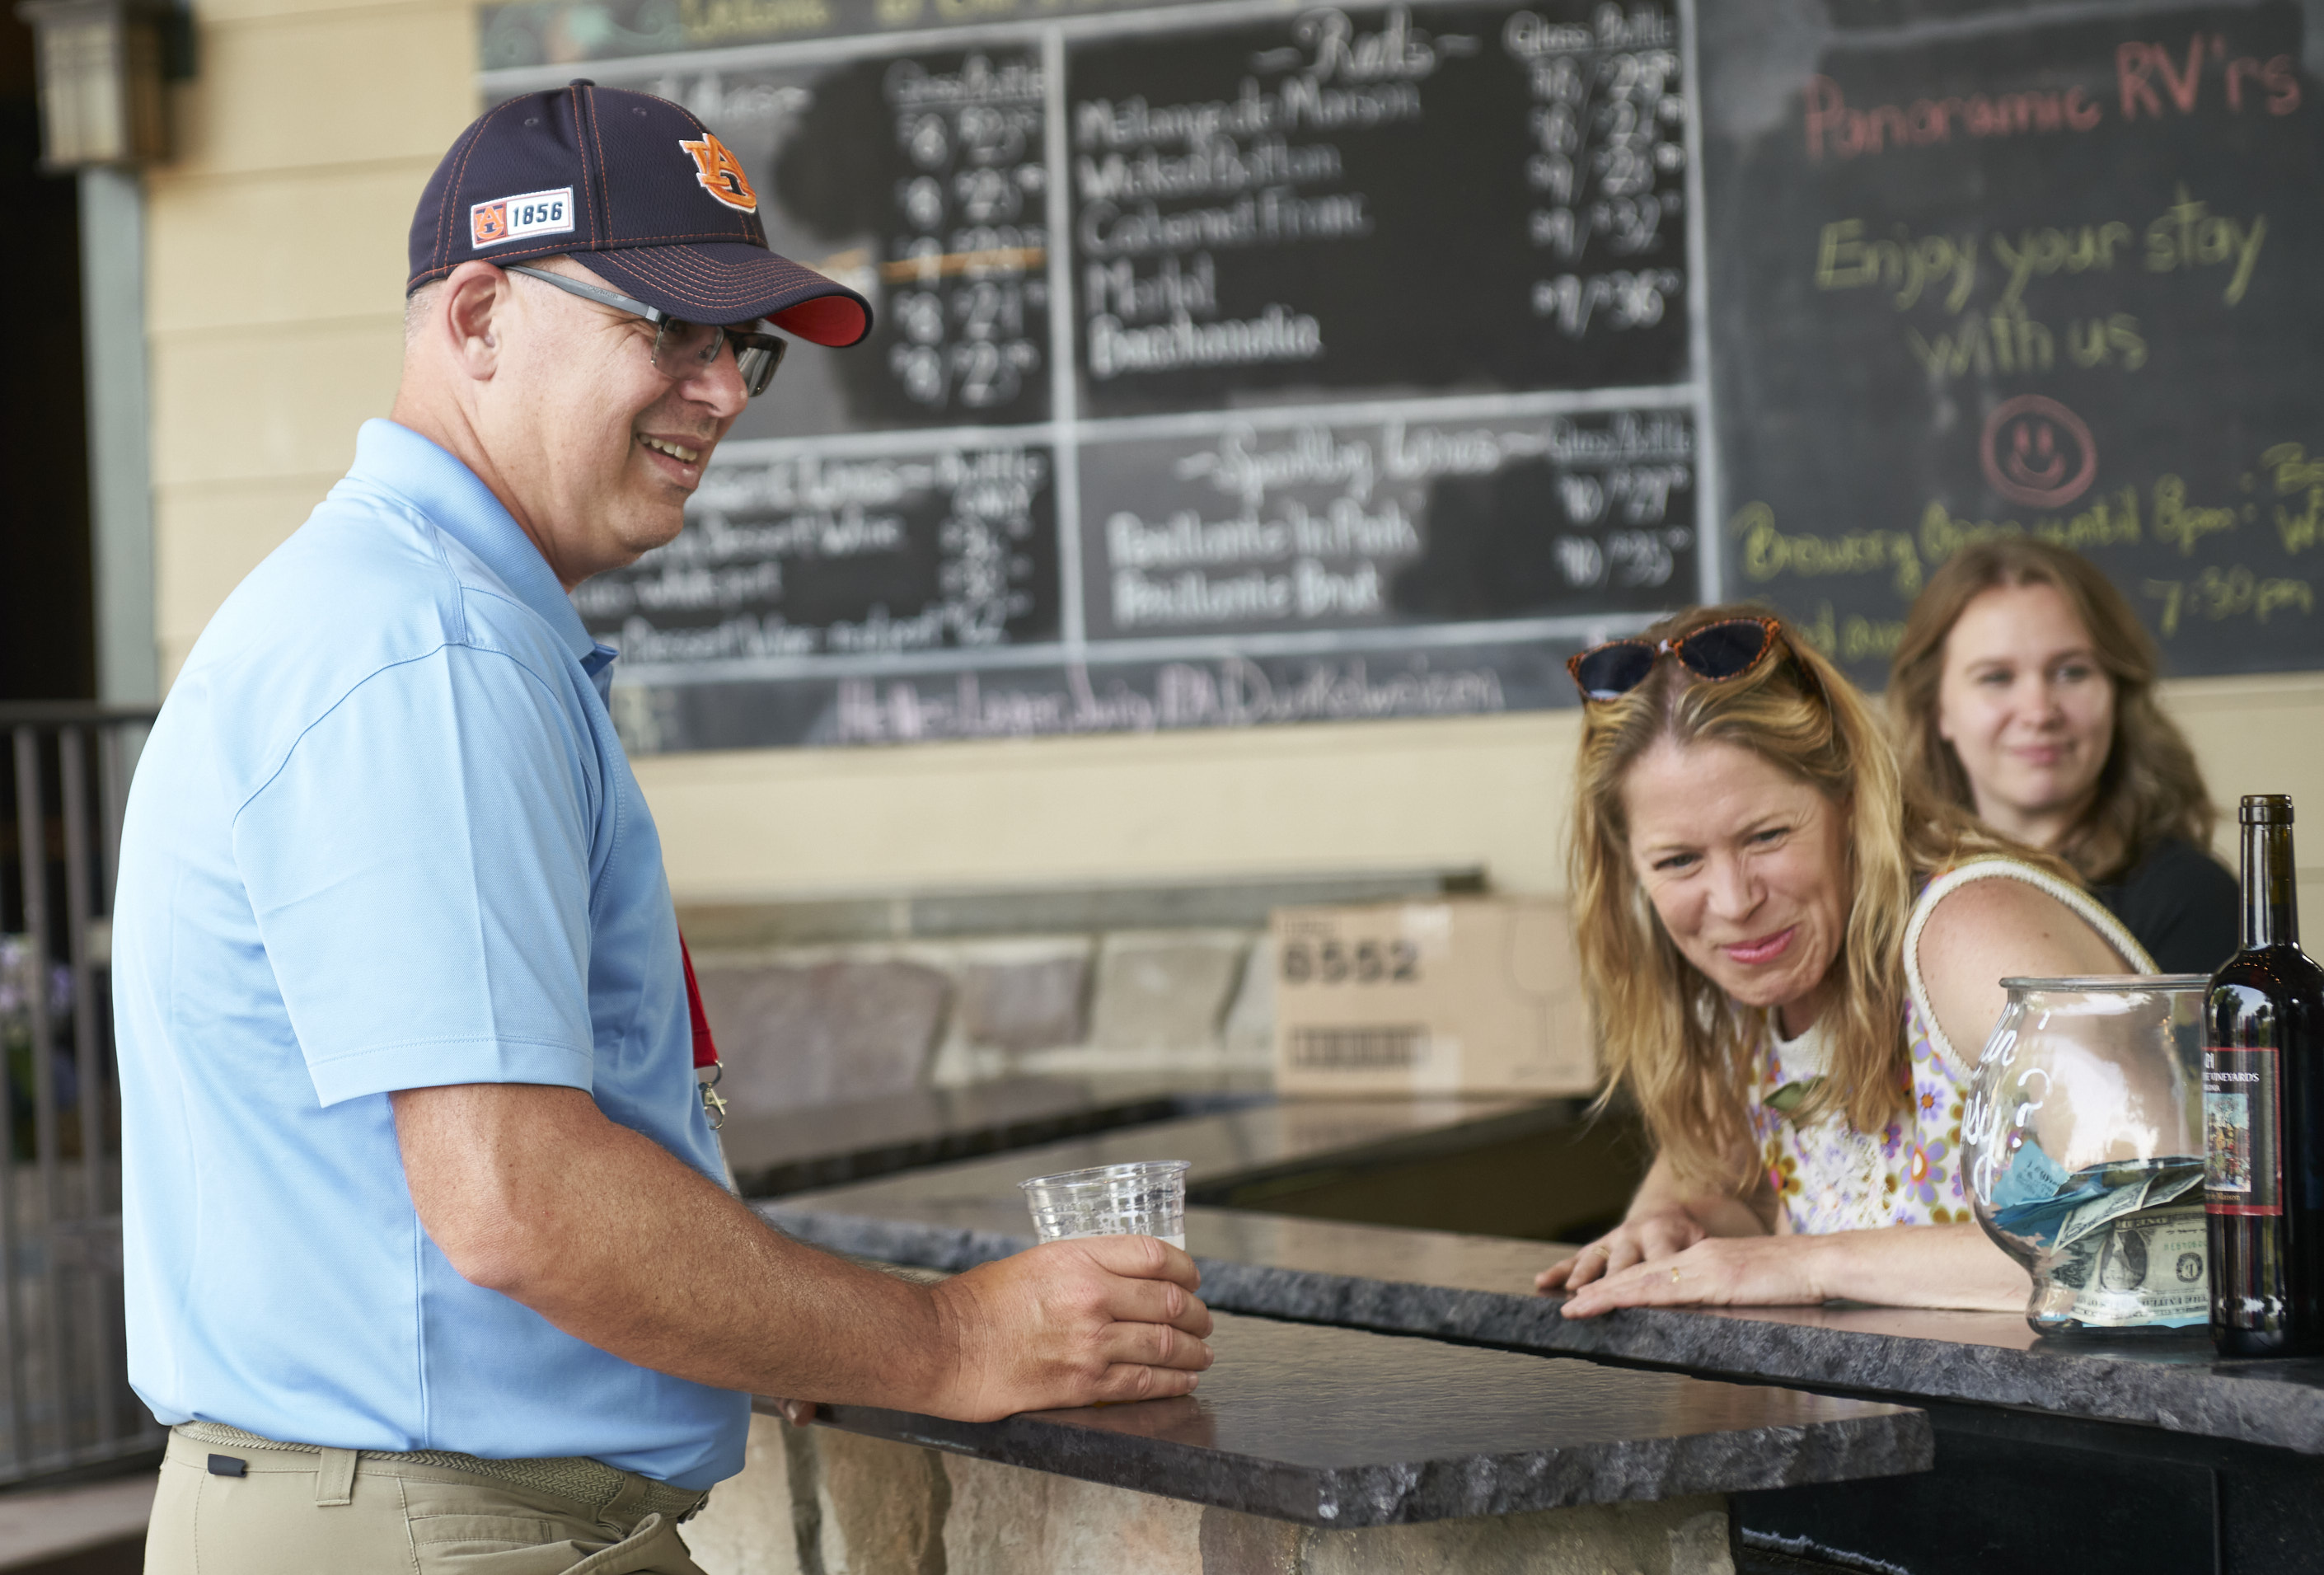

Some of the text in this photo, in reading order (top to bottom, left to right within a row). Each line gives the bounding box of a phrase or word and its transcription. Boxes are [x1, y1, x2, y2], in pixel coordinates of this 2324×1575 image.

[1803, 73, 2104, 159] Panoramic
[513, 201, 564, 227] 1856
[1816, 179, 2269, 314] Enjoy your stay
[1905, 298, 2148, 378] with us
[1734, 499, 1923, 599] Brewery
